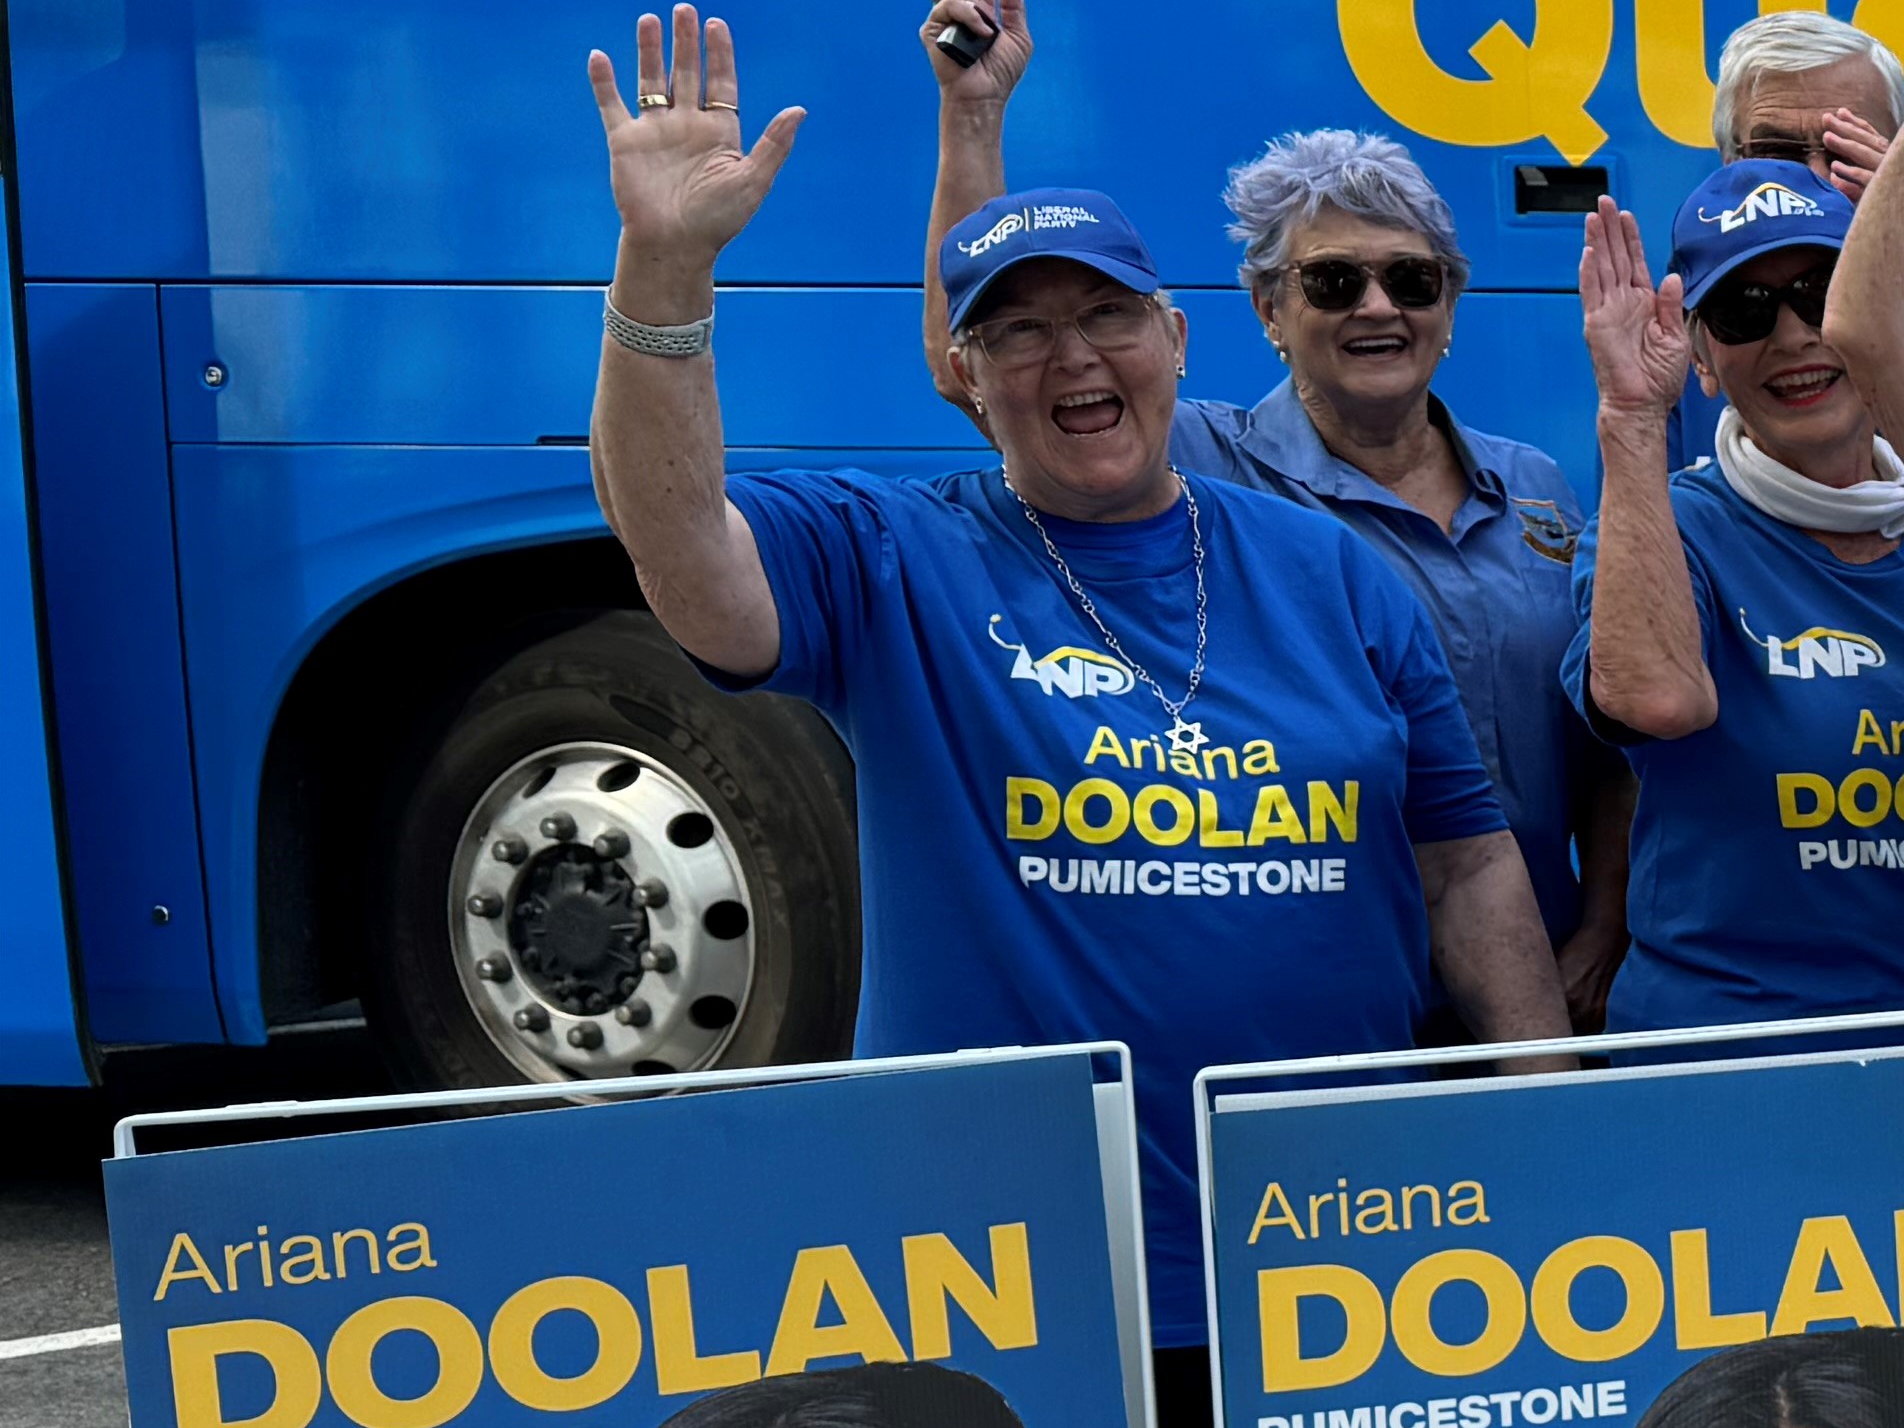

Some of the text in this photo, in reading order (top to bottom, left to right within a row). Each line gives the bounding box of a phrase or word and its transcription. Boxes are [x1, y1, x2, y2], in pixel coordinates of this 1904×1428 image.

[1720, 188, 1807, 234] LNP
[1766, 634, 1879, 679] LNP
[1083, 724, 1281, 781] Ariana
[1005, 776, 1360, 848] DOOLAN
[1018, 855, 1347, 897] PUMICESTONE
[1245, 1178, 1491, 1245] Ariana
[151, 1220, 438, 1302] Ariana
